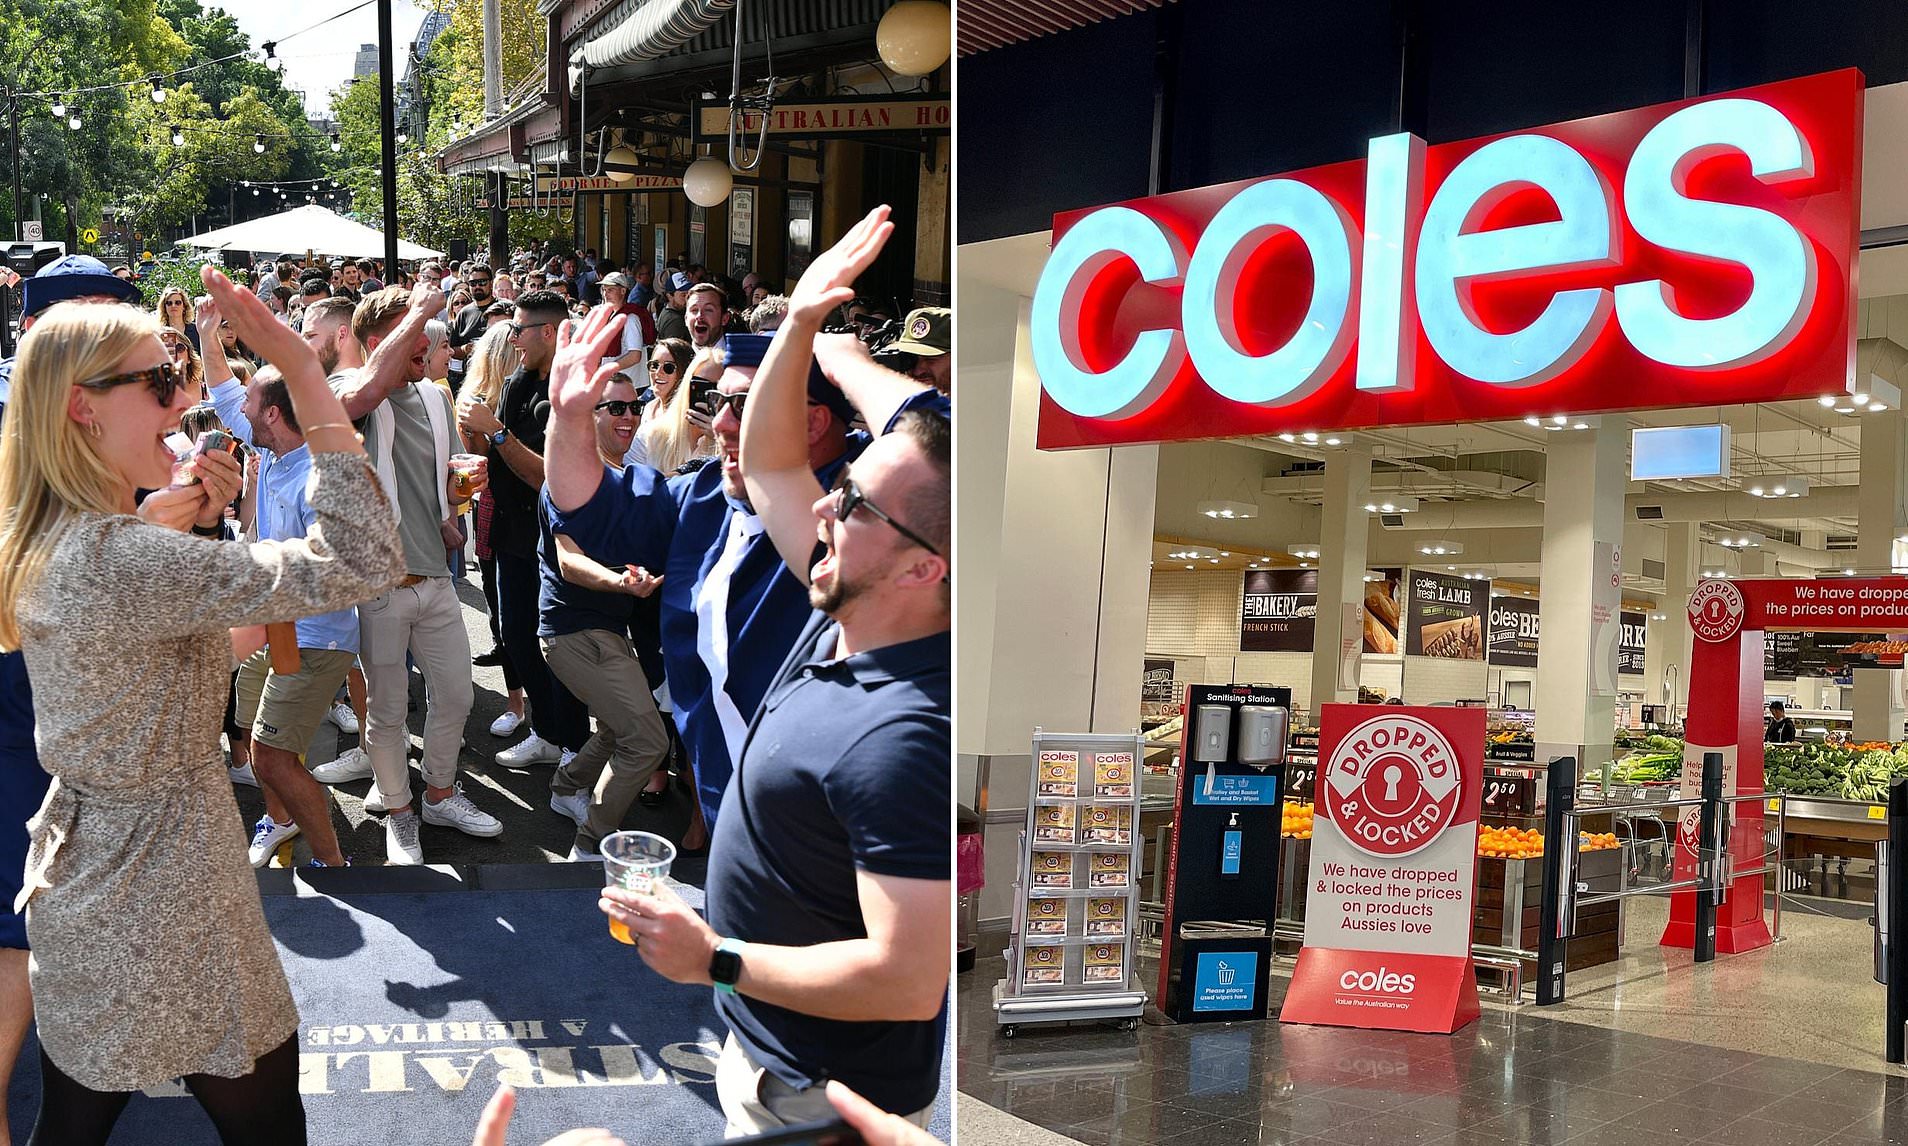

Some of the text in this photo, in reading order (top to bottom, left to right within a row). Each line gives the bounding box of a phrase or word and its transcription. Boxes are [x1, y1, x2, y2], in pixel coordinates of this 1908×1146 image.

[31, 227, 40, 235] 40
[1031, 97, 1815, 418] coles
[1415, 578, 1438, 590] coles
[1795, 586, 1816, 599] We
[1820, 586, 1855, 599] have
[1416, 587, 1472, 605] fresh LAMB
[1693, 583, 1738, 607] DROPPED
[1244, 596, 1298, 616] THE BAKERY
[1766, 603, 1788, 616] the
[1791, 603, 1834, 618] prices
[1838, 605, 1856, 616] on
[1243, 623, 1289, 632] FRENCH STICK
[1699, 617, 1736, 637] LOCKED
[1206, 693, 1276, 704] Sanitising Station
[1041, 752, 1077, 761] coles
[1096, 755, 1132, 763] coles
[1339, 726, 1448, 779] DROPPED
[1340, 800, 1442, 846] & LOCKED
[1323, 862, 1458, 885] We have dropped
[1316, 879, 1462, 901] & locked the prices
[1342, 901, 1433, 917] on products
[1341, 916, 1432, 935] Aussies love
[1340, 967, 1416, 994] coles
[1225, 987, 1244, 995] place
[1335, 998, 1353, 1006] Value
[1353, 999, 1364, 1007] the
[1364, 1001, 1395, 1009] Australian
[308, 1019, 589, 1046] A HERITAGE
